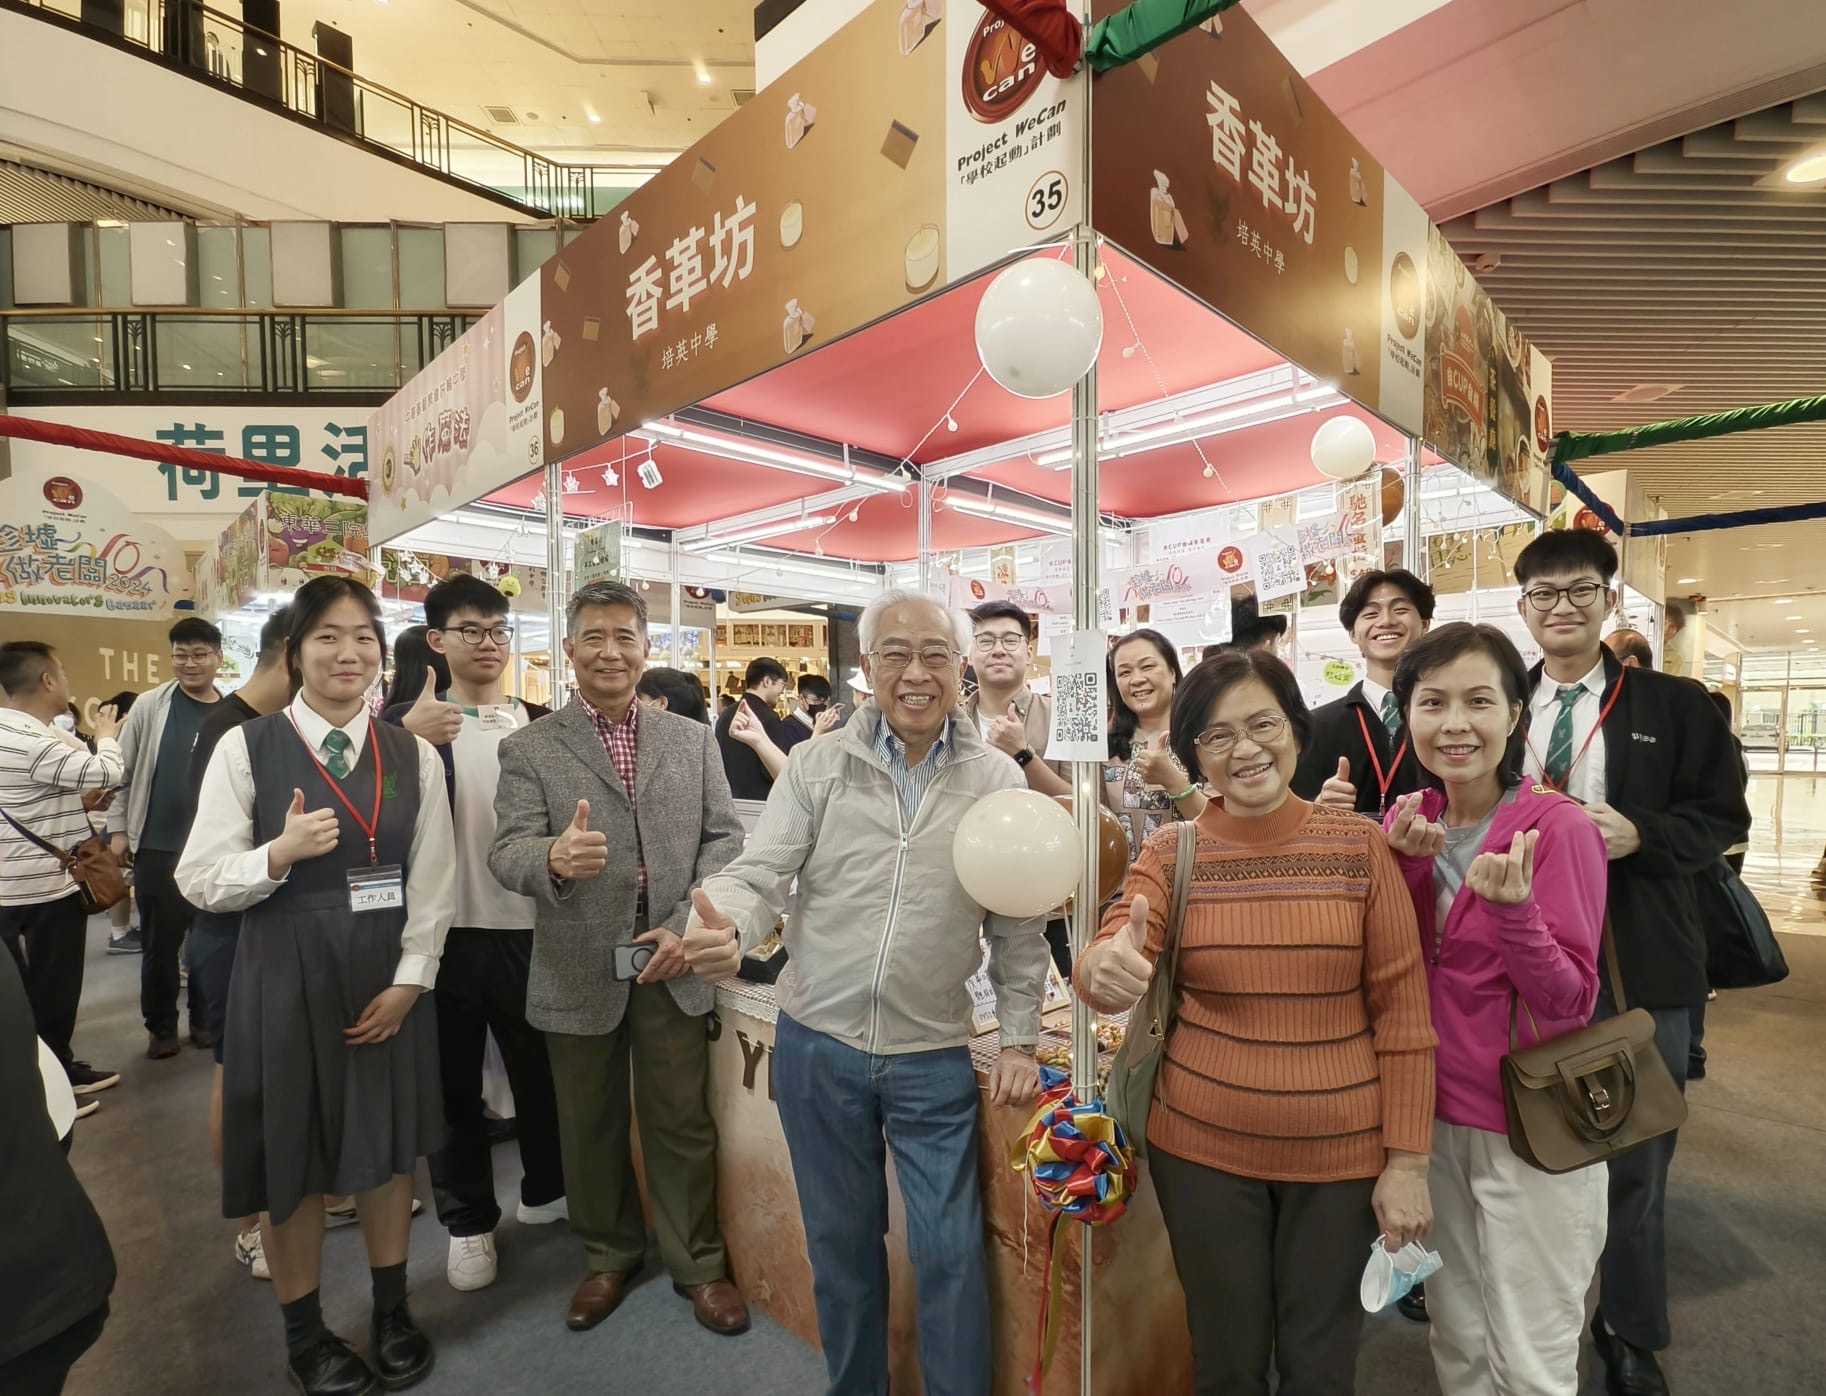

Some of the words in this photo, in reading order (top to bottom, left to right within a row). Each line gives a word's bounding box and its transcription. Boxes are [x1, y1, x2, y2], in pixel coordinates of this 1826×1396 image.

[982, 62, 1036, 102] can
[957, 132, 1008, 172] Project
[1014, 99, 1066, 139] WeCan
[1206, 79, 1317, 245] 香革坊
[1031, 179, 1063, 219] 35
[625, 194, 757, 341] 香革坊
[1236, 217, 1287, 275] 培英中學
[662, 322, 720, 370] 培英中學
[529, 440, 540, 458] 36
[98, 647, 160, 684] THE
